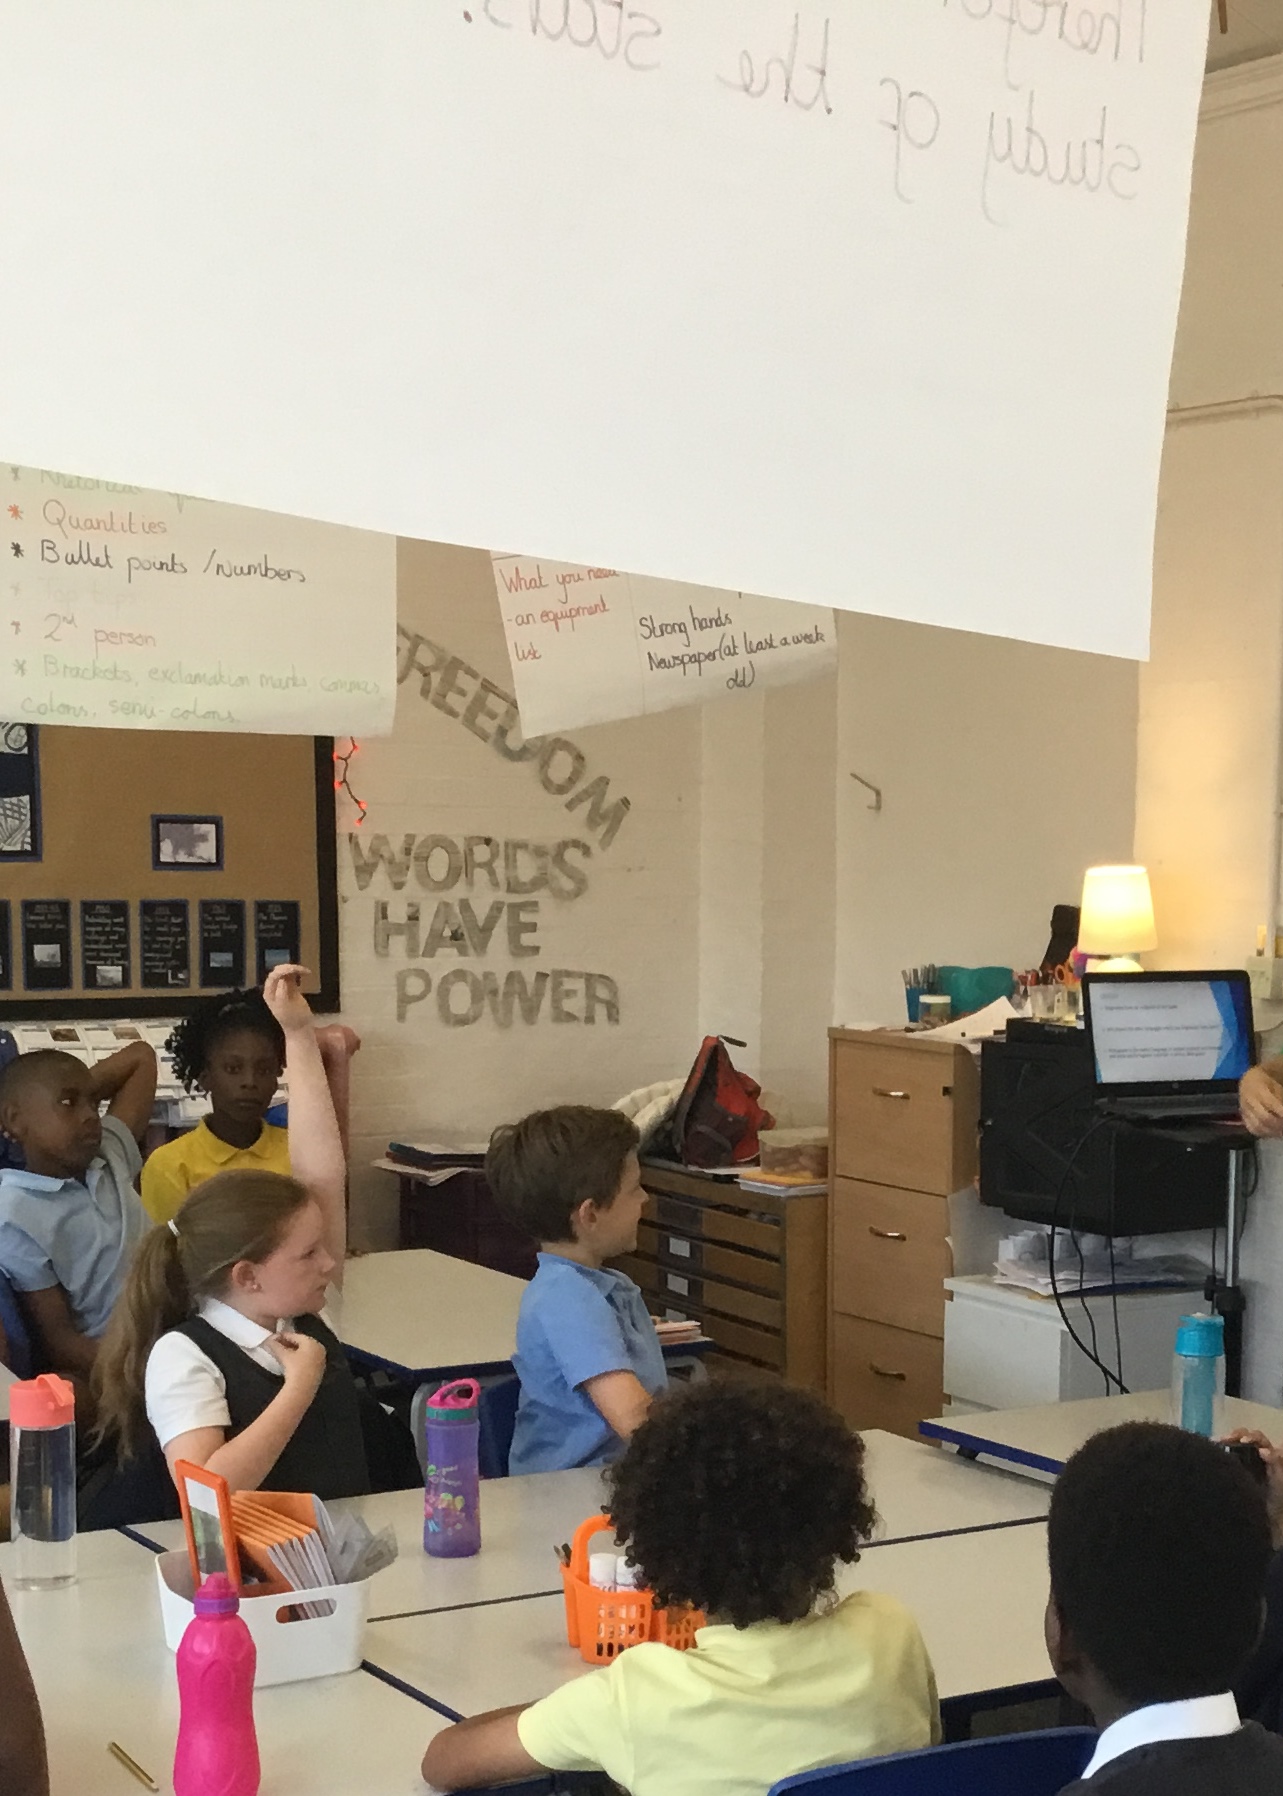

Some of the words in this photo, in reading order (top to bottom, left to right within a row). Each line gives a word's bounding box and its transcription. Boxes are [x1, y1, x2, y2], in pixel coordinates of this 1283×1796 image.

[43, 499, 168, 539] Quantities
[41, 539, 113, 569] Bullet
[127, 553, 188, 583] points
[499, 564, 549, 594] What
[556, 568, 584, 604] you
[540, 595, 610, 632] equipment
[639, 616, 692, 647] Strong
[689, 605, 733, 632] hands
[94, 627, 156, 659] person
[515, 641, 541, 662] list
[743, 631, 778, 654] least
[780, 636, 791, 648] a
[792, 624, 826, 645] week
[148, 661, 250, 688] exclamation
[726, 660, 757, 690] old)
[350, 832, 593, 901] WORDS
[374, 898, 541, 959] HAVE
[396, 967, 620, 1029] POWER
